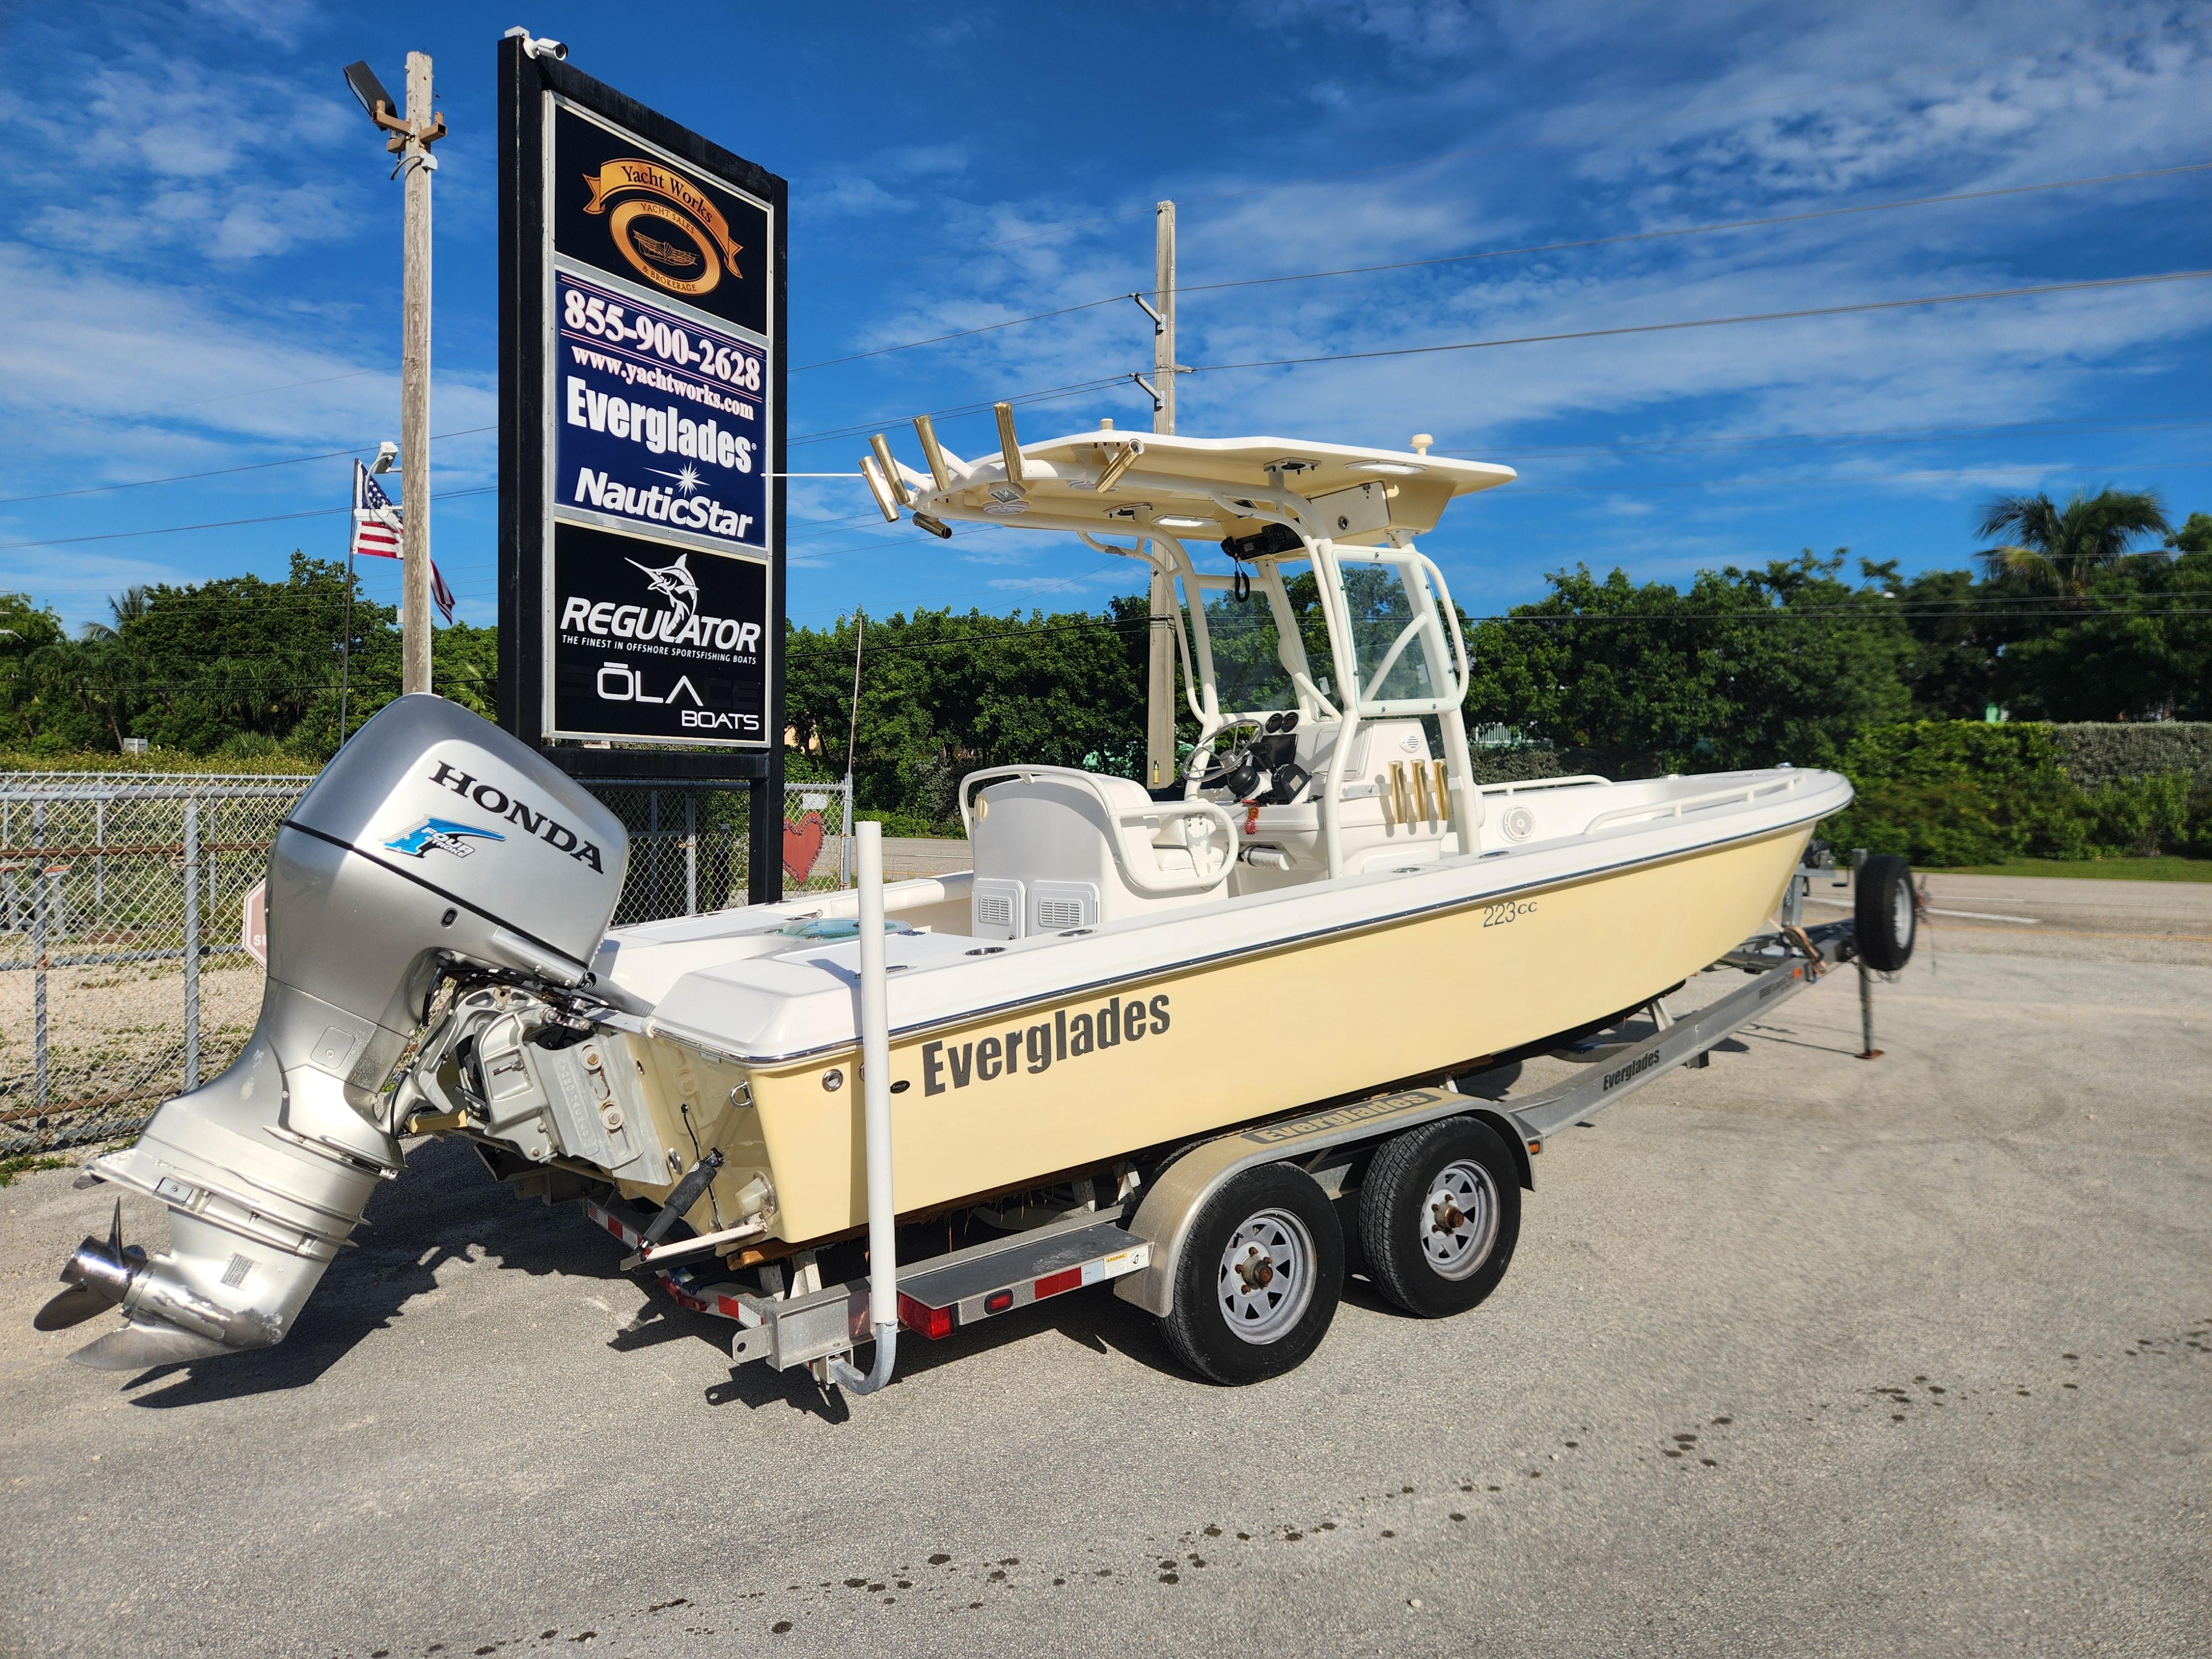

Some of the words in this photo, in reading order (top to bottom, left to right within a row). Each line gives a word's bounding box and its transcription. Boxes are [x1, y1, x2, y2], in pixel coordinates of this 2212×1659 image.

[620, 165, 664, 189] Yacht
[669, 176, 713, 223] Works
[640, 202, 670, 218] YACHT
[672, 210, 695, 234] SALES
[650, 270, 697, 292] BROKERAGE
[565, 289, 760, 392] 855-900-2628
[571, 346, 754, 420] www.yachtworks.com
[574, 467, 753, 538] NauticStar
[560, 597, 760, 653] REGULATOR
[562, 634, 578, 645] THE
[581, 637, 611, 649] FINEST
[614, 641, 623, 650] IN
[626, 643, 669, 655] OFFSHORE
[671, 648, 731, 662] SPORTSFISHING
[733, 655, 757, 665] BOATS
[681, 709, 759, 731] BOATS
[421, 827, 474, 854] FOUR
[428, 760, 604, 875] HONDA
[425, 836, 466, 858] STROKE
[922, 994, 1170, 1097] Everglades
[1603, 1049, 1660, 1092] Everglades
[1255, 1093, 1429, 1142] Everglades
